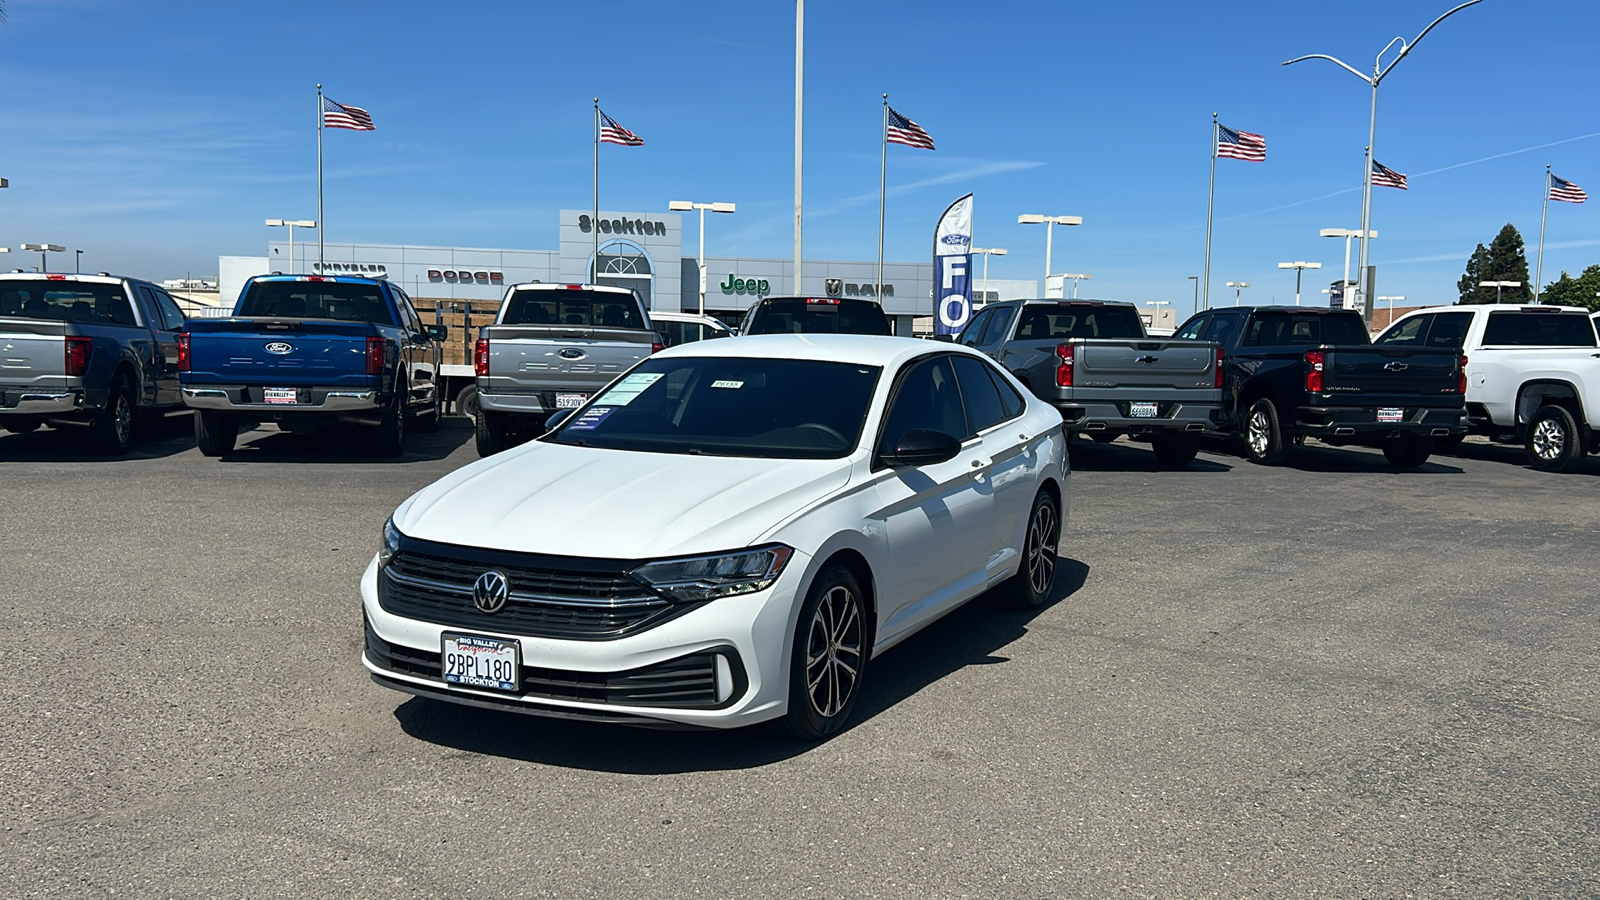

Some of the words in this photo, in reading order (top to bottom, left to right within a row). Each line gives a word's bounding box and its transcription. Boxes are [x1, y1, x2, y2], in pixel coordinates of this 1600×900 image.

[578, 214, 666, 236] Stockton
[946, 235, 967, 245] Ford
[427, 269, 504, 285] DODGE
[720, 273, 770, 295] Jeep
[845, 283, 895, 297] RAM
[472, 638, 499, 648] VALLEY
[447, 652, 512, 682] 9BPL180
[459, 676, 500, 688] STOCKTON
